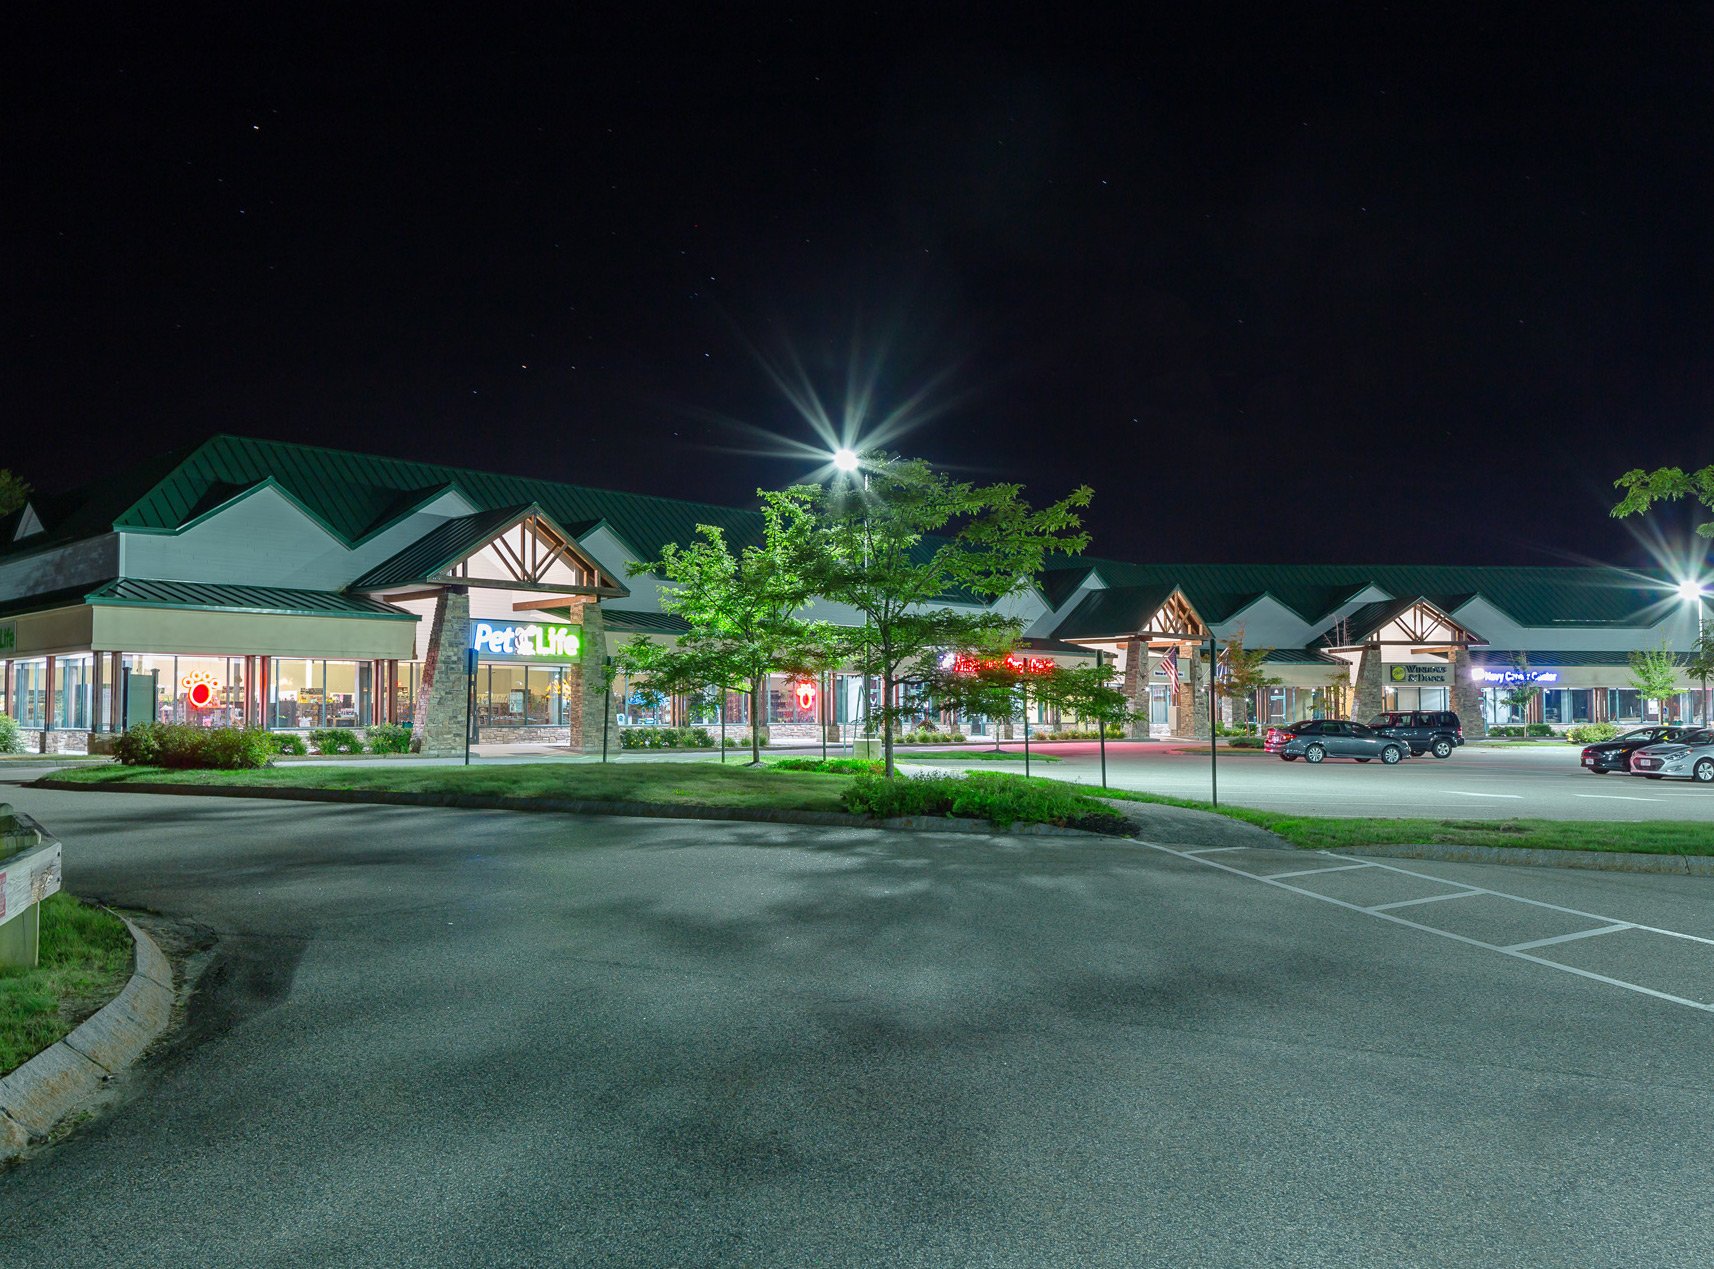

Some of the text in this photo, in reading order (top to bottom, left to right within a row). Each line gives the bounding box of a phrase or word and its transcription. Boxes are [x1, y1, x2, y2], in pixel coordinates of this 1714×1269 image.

[474, 623, 580, 656] Pet Life
[1485, 671, 1558, 683] Navy Carer Center
